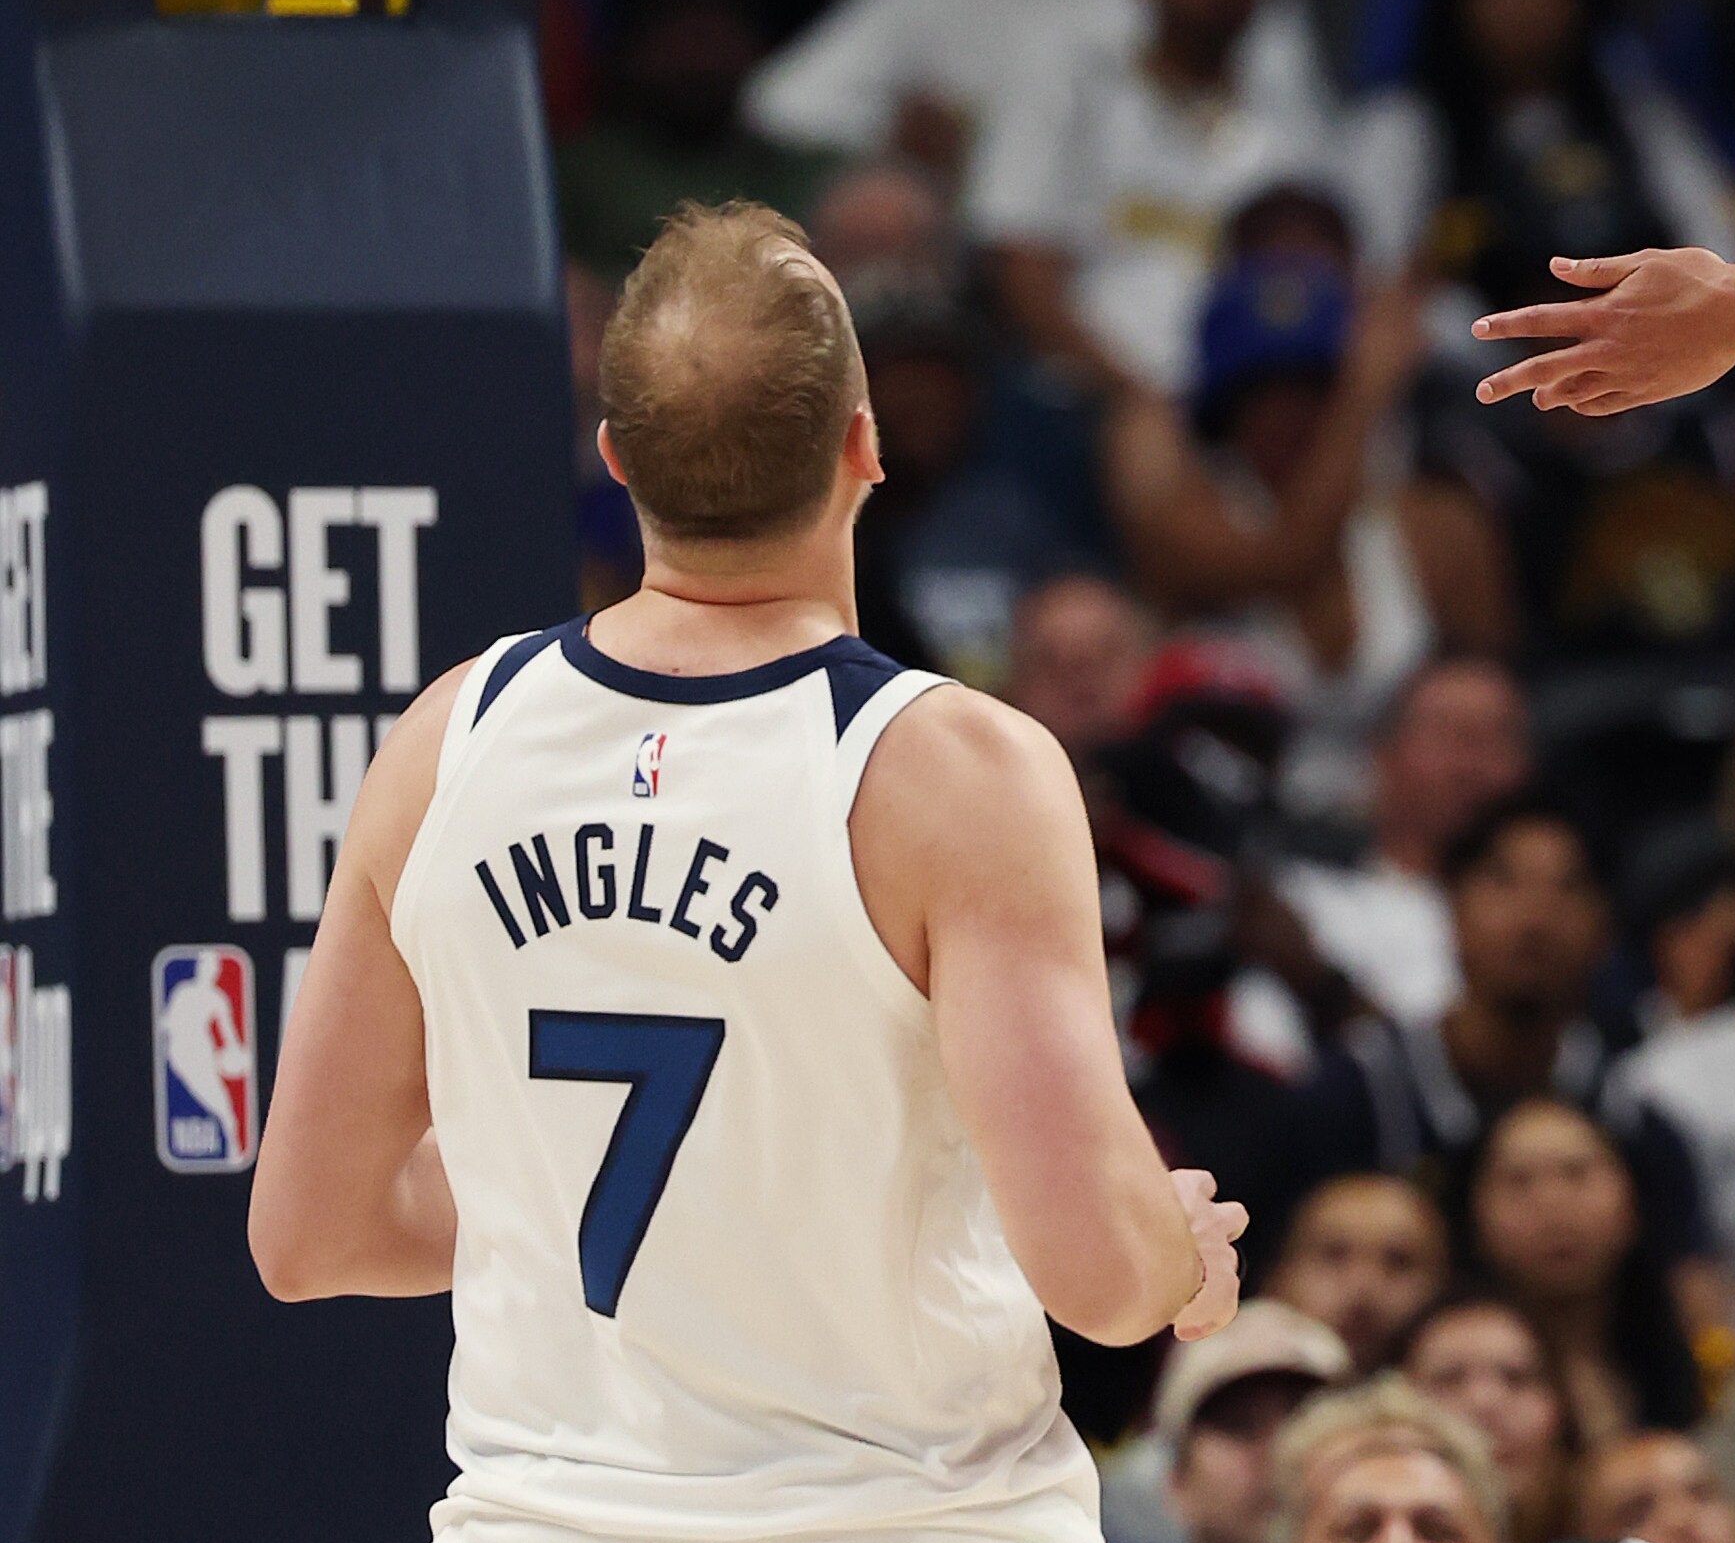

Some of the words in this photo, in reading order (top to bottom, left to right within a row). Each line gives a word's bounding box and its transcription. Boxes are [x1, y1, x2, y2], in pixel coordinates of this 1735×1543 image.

[200, 484, 438, 696] GET
[202, 713, 400, 924] TH
[474, 822, 779, 964] INGLES
[528, 1008, 726, 1320] 7
